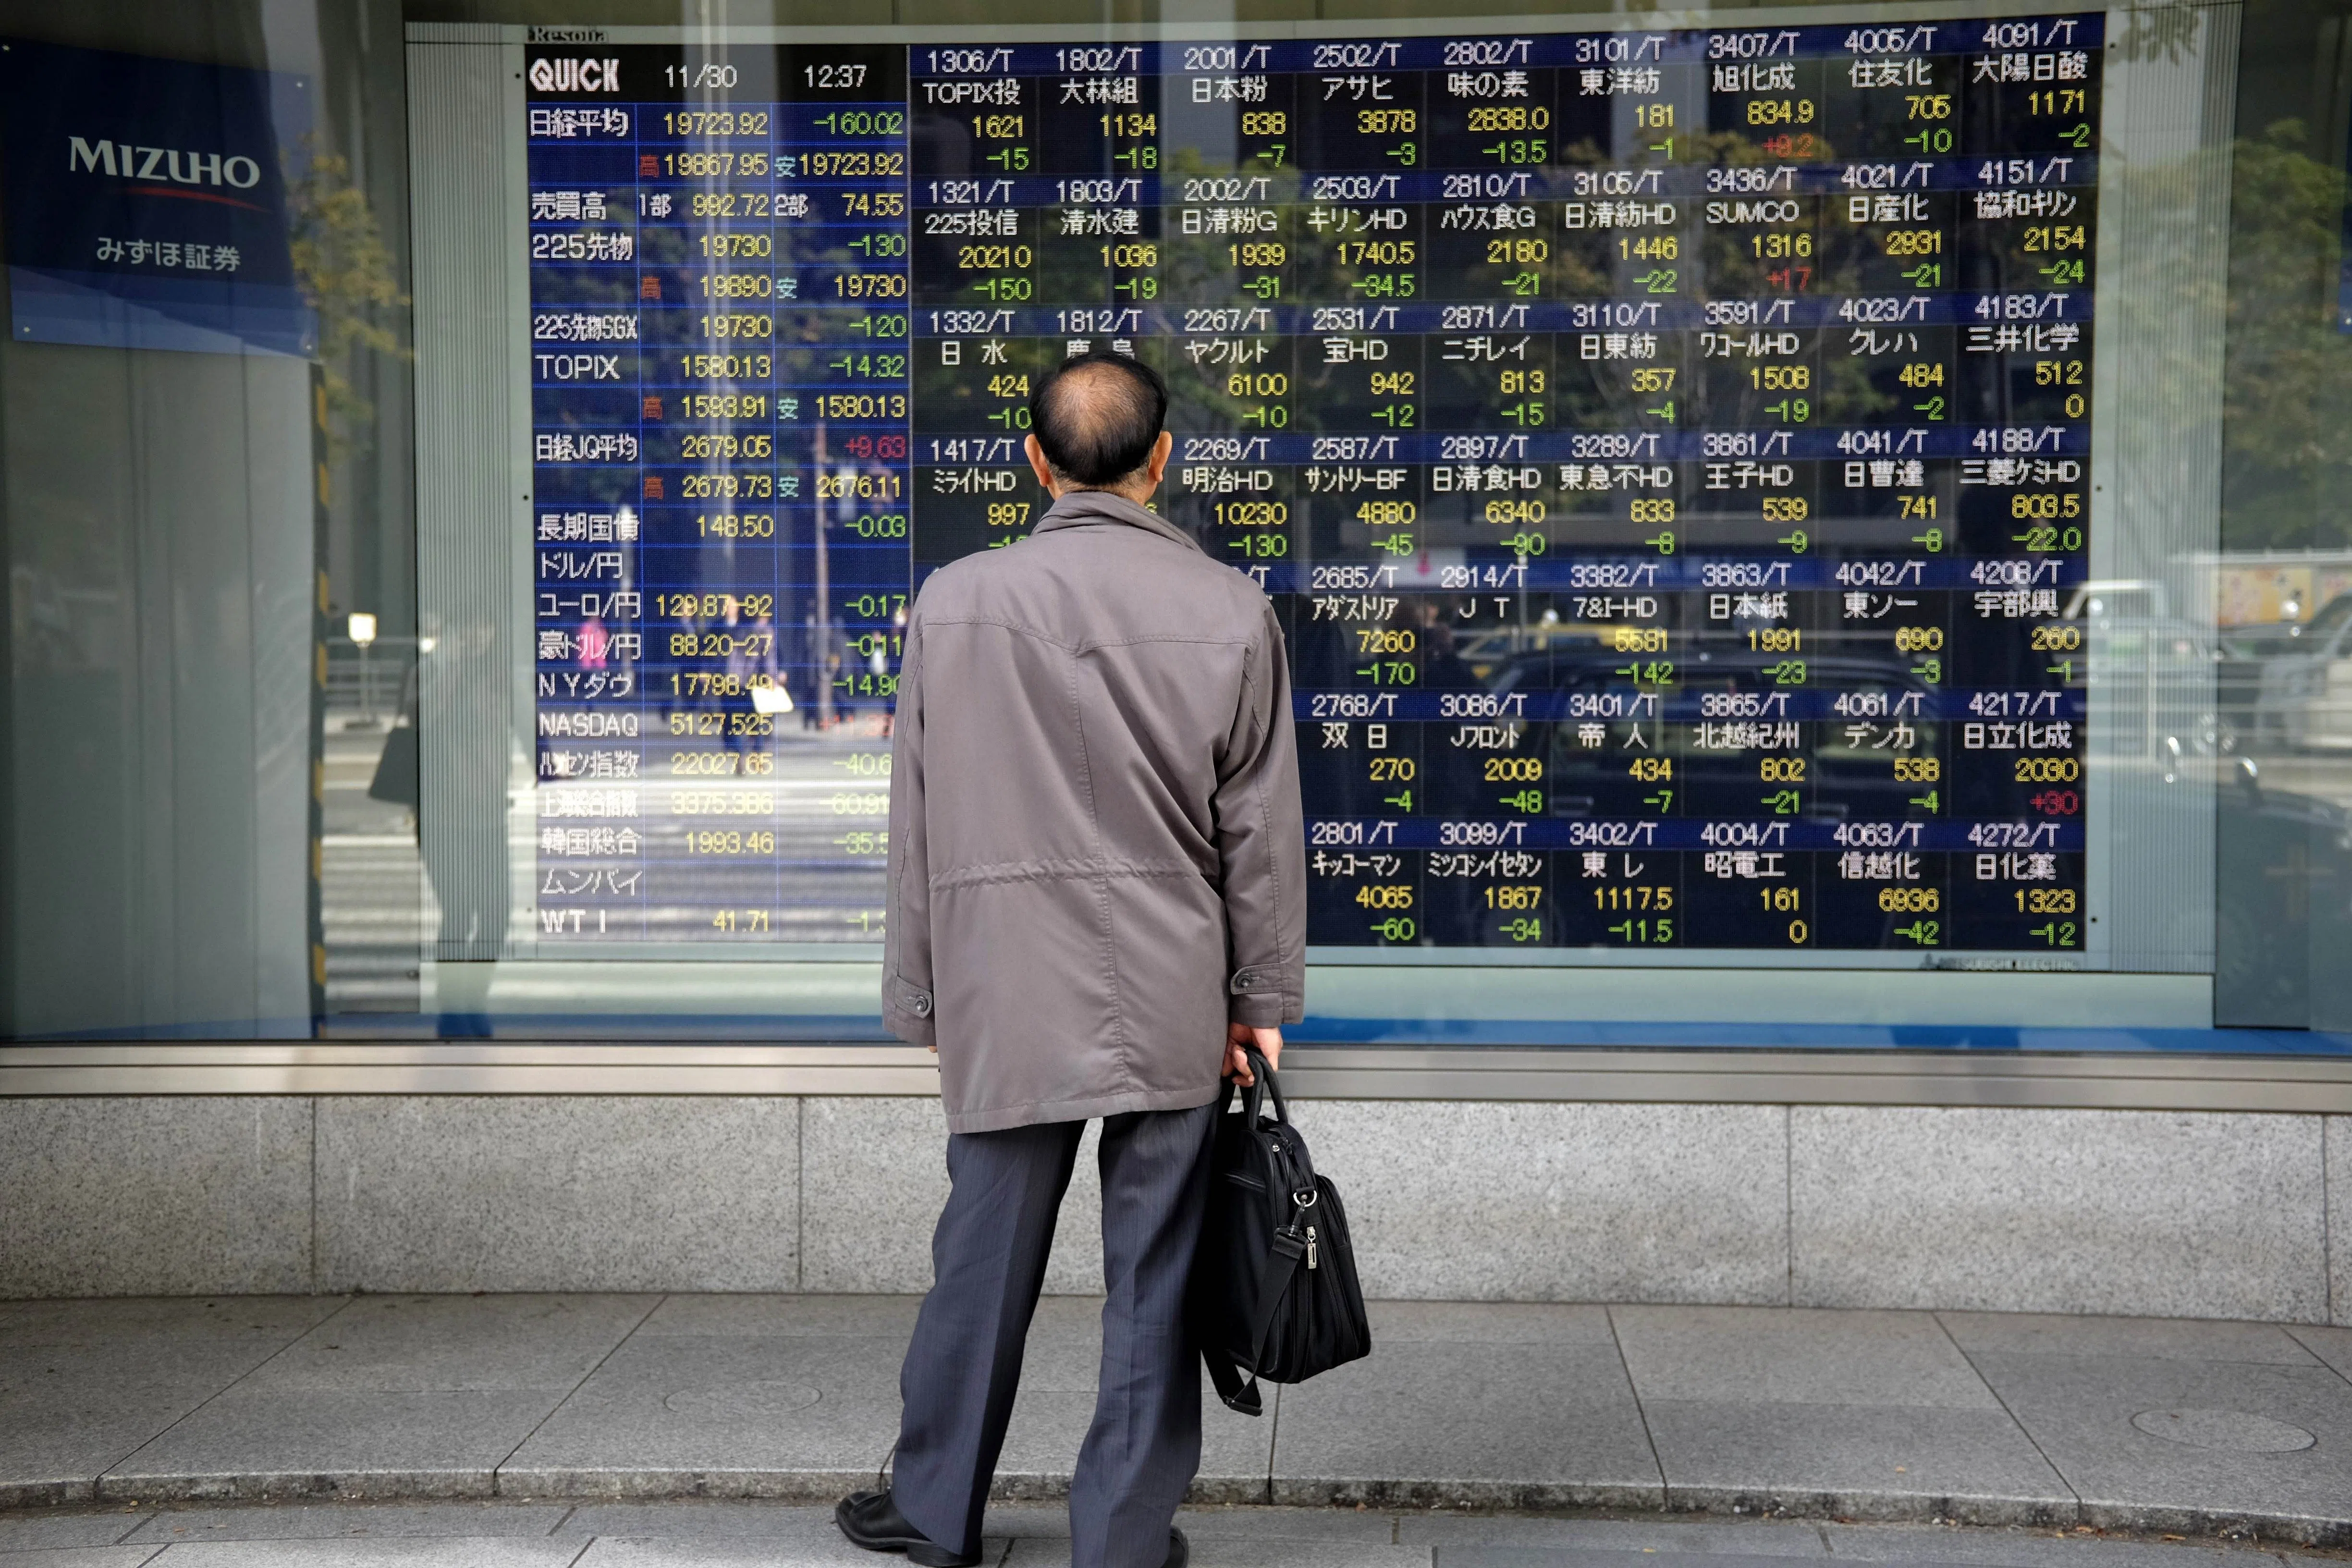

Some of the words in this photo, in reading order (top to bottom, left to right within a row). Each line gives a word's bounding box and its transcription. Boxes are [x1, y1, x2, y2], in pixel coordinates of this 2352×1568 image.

[1709, 31, 1801, 59] 3407/T
[1844, 26, 1937, 53] 4005/T
[1982, 19, 2078, 48] 4091/T
[928, 48, 1014, 73] 1306/T
[1056, 46, 1142, 72] 1802/T
[1184, 44, 1272, 70] 2001/T
[1313, 42, 1402, 68] 2502/T
[1444, 38, 1533, 65] 2802/T
[1575, 35, 1666, 62] 3101/T
[529, 58, 620, 92] QUICK
[665, 62, 737, 87] 11/30
[804, 63, 867, 87] 12:37
[1713, 62, 1795, 92] 旭化成
[1849, 58, 1932, 88] 住友化
[1192, 75, 1267, 103] 日本粉
[1321, 75, 1393, 100] アサヒ
[1747, 99, 1814, 124] 834.9
[1905, 94, 1951, 120] 705
[2029, 89, 2085, 115] 1171
[530, 108, 628, 138] 日経平均
[664, 111, 767, 135] 19723.92
[813, 111, 903, 135] -160.02
[972, 114, 1024, 138] 1621
[1100, 113, 1156, 136] 1134
[1468, 106, 1549, 131] 2838.0
[1635, 104, 1674, 128] 181
[69, 136, 260, 188] MIZUHO
[986, 147, 1029, 170] -15
[1482, 139, 1547, 163] -13.5
[664, 153, 768, 176] 19867.95
[800, 153, 903, 176] 19723.92
[1842, 162, 1934, 188] 4021/T
[1979, 157, 2073, 184] 4151/T
[929, 179, 1014, 203] 1321/T
[1056, 178, 1142, 203] 1803/T
[1184, 176, 1272, 201] 2002/T
[1443, 172, 1531, 198] 2810/T
[1707, 166, 1798, 192] 3436/T
[532, 191, 606, 219] 売買高
[842, 193, 904, 216] 74.55
[1707, 199, 1800, 223] SUMCO
[925, 209, 1018, 235] 225投信
[533, 233, 632, 260] 225先物
[699, 234, 771, 257] 19730
[847, 234, 906, 256] -130
[1487, 238, 1548, 263] 2180
[1618, 236, 1678, 260] 1446
[1752, 233, 1812, 258] 1316
[2024, 226, 2085, 251] 2154
[97, 236, 241, 272] みずほ証券
[959, 245, 1031, 268] 20210
[1337, 241, 1415, 265] 1740.5
[699, 275, 771, 297] 19890
[835, 275, 906, 297] 19730
[973, 277, 1031, 301] -150
[1351, 273, 1414, 297] -34.5
[1313, 306, 1400, 331] 2531/T
[1442, 303, 1531, 330] 2871/T
[1572, 301, 1662, 328] 3110/T
[1839, 295, 1931, 322] 4023/T
[1974, 292, 2069, 320] 4183/T
[700, 315, 772, 338] 19730
[849, 314, 906, 337] -120
[930, 309, 1016, 333] 1332/T
[1057, 308, 1142, 332] 1812/T
[1185, 307, 1272, 331] 2267/T
[1185, 338, 1269, 364] ヤクルト
[1323, 337, 1388, 363] 宝HD
[1442, 335, 1531, 362] ニチレイ
[1849, 328, 1918, 355] クレハ
[536, 354, 620, 380] TOPIX
[681, 355, 770, 378] 1580.13
[830, 354, 904, 377] -14.32
[1899, 363, 1944, 387] 484
[2036, 360, 2083, 385] 512
[988, 374, 1028, 397] 424
[1228, 373, 1287, 396] 6100
[1371, 372, 1414, 395] 942
[1501, 369, 1544, 393] 813
[1632, 368, 1676, 392] 357
[681, 395, 766, 417] 1593.91
[816, 395, 906, 417] 1580.13
[1501, 402, 1544, 426] -15
[682, 435, 772, 457] 2679.05
[845, 435, 906, 458] +9.63
[931, 438, 1016, 462] 1417/T
[1185, 436, 1271, 461] 2269/T
[1312, 436, 1400, 460] 2587/T
[1441, 434, 1530, 459] 2897/T
[1571, 432, 1661, 457] 3289/T
[1837, 428, 1929, 454] 4041/T
[682, 475, 772, 498] 2679.73
[816, 475, 900, 497] 2676.11
[1183, 467, 1273, 493] 明治HD
[1705, 460, 1793, 489] 王子HD
[988, 502, 1030, 525] 997
[1214, 502, 1287, 525] 10230
[1356, 501, 1416, 525] 4880
[1485, 500, 1545, 524] 6340
[1631, 499, 1675, 523] 833
[1763, 497, 1808, 521] 539
[1898, 495, 1937, 519] 741
[2012, 493, 2081, 519] 803.5
[696, 514, 773, 537] 148.50
[845, 514, 906, 537] -0.03
[1228, 534, 1287, 557] -130
[1312, 565, 1398, 589] 2685/T
[1571, 563, 1659, 588] 3382/T
[1836, 561, 1926, 586] 4042/T
[539, 592, 641, 618] ユーロ/円
[845, 595, 906, 617] -0.17
[670, 635, 773, 656] 88.20-27
[1357, 630, 1415, 653] 7260
[1356, 662, 1415, 685] -170
[1616, 662, 1674, 685] -142
[1312, 694, 1398, 717] 2768/T
[1441, 693, 1528, 717] 3086/T
[1570, 692, 1658, 717] 3401/T
[1702, 692, 1791, 717] 3865/T
[1969, 690, 2061, 717] 4217/T
[539, 713, 637, 736] NASDAQ
[670, 713, 773, 735] 5127.525
[1844, 722, 1915, 748] デンカ
[1370, 758, 1414, 782] 270
[1629, 758, 1673, 781] 434
[1761, 758, 1805, 782] 802
[1894, 758, 1940, 782] 538
[541, 828, 642, 856] 韓国総合
[686, 831, 774, 854] 1993.46
[1312, 822, 1398, 845] 2801/T
[1440, 821, 1528, 845] 3099/T
[1569, 821, 1658, 845] 3402/T
[1701, 822, 1790, 847] 4004/T
[1968, 822, 2060, 847] 4272/T
[541, 868, 642, 896] ムンバイ
[1356, 885, 1413, 909] 4065
[1485, 886, 1542, 909] 1867
[1594, 886, 1673, 911] 1117.5
[1761, 888, 1800, 911] 161
[2014, 889, 2076, 912] 1323
[713, 910, 768, 933] 41.71
[1608, 919, 1673, 943] -11.5
